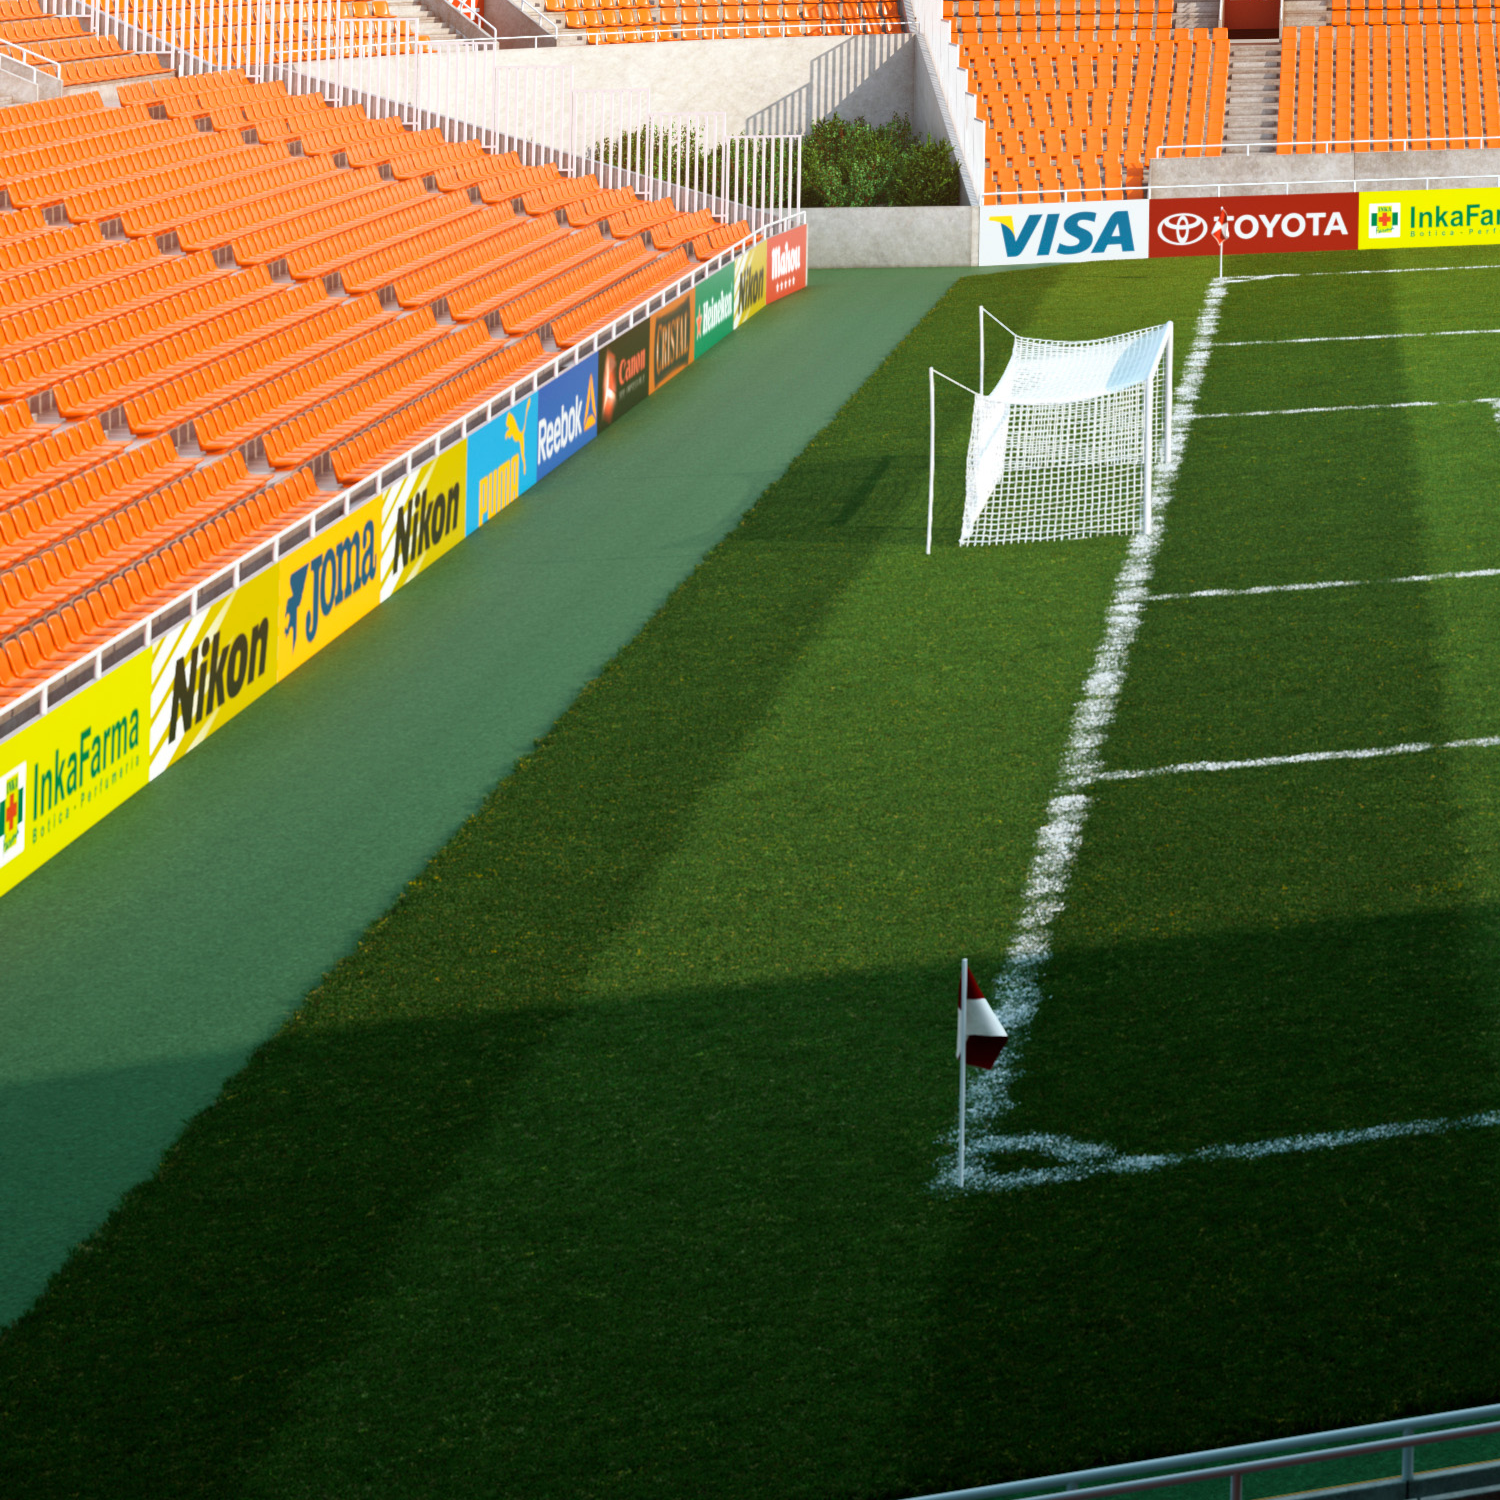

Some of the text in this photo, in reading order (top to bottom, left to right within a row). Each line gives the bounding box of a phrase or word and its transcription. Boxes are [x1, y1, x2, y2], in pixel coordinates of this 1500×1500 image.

[988, 210, 1135, 257] VISA
[702, 290, 733, 336] Heineken
[739, 264, 764, 315] Nikon
[619, 348, 646, 385] Canon
[656, 311, 689, 375] CRISTAL
[537, 394, 583, 466] Reebok
[478, 453, 520, 527] PUMA
[393, 482, 460, 576] Nikon
[305, 520, 377, 643] Joma
[168, 617, 269, 745] Nikon
[33, 708, 139, 821] InkaFarma
